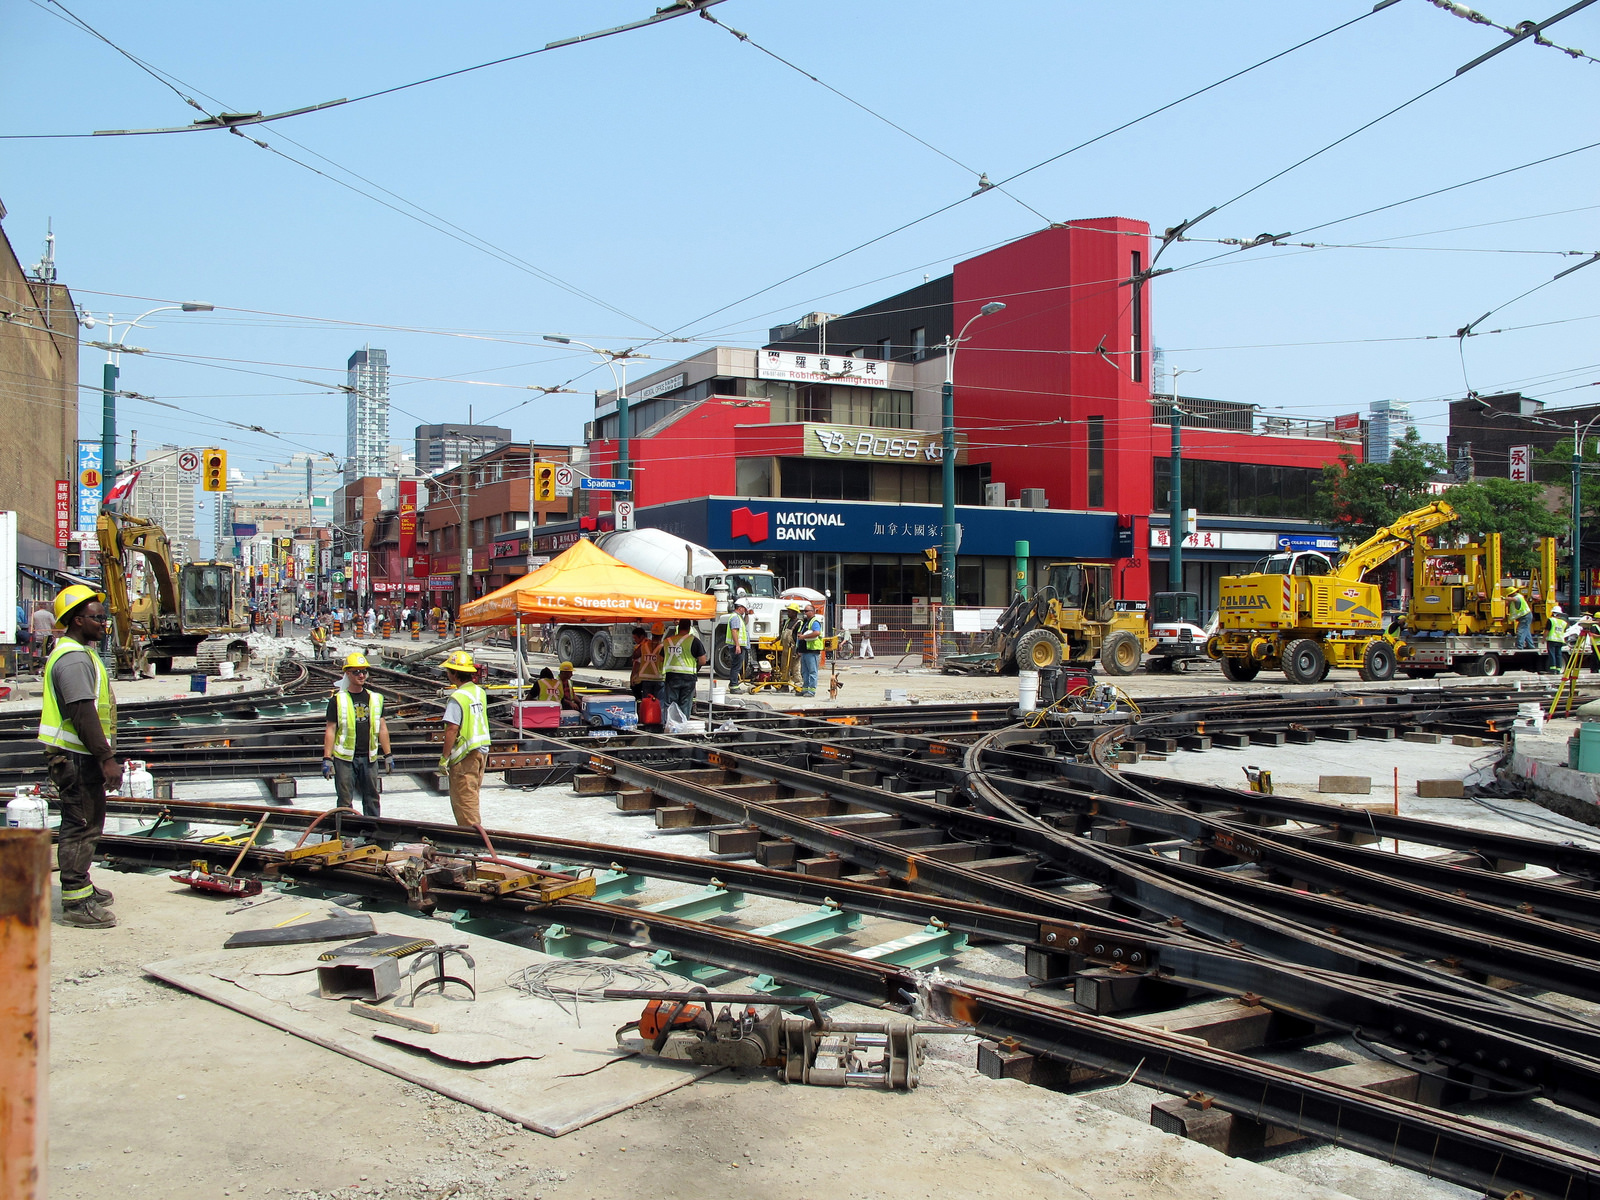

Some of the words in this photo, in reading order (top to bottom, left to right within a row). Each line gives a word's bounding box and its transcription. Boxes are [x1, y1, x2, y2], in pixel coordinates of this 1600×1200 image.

[587, 479, 616, 489] Spadina
[57, 482, 69, 547] 新時代圖書公司
[776, 512, 845, 527] NATIONAL
[776, 527, 816, 541] BANK
[1157, 530, 1215, 548] 羅移民
[1125, 558, 1141, 568] 283
[574, 596, 631, 608] Streetcar
[633, 598, 660, 612] Way
[674, 600, 702, 610] 0735
[1116, 602, 1127, 611] CAT
[1220, 595, 1272, 609] COLMAR
